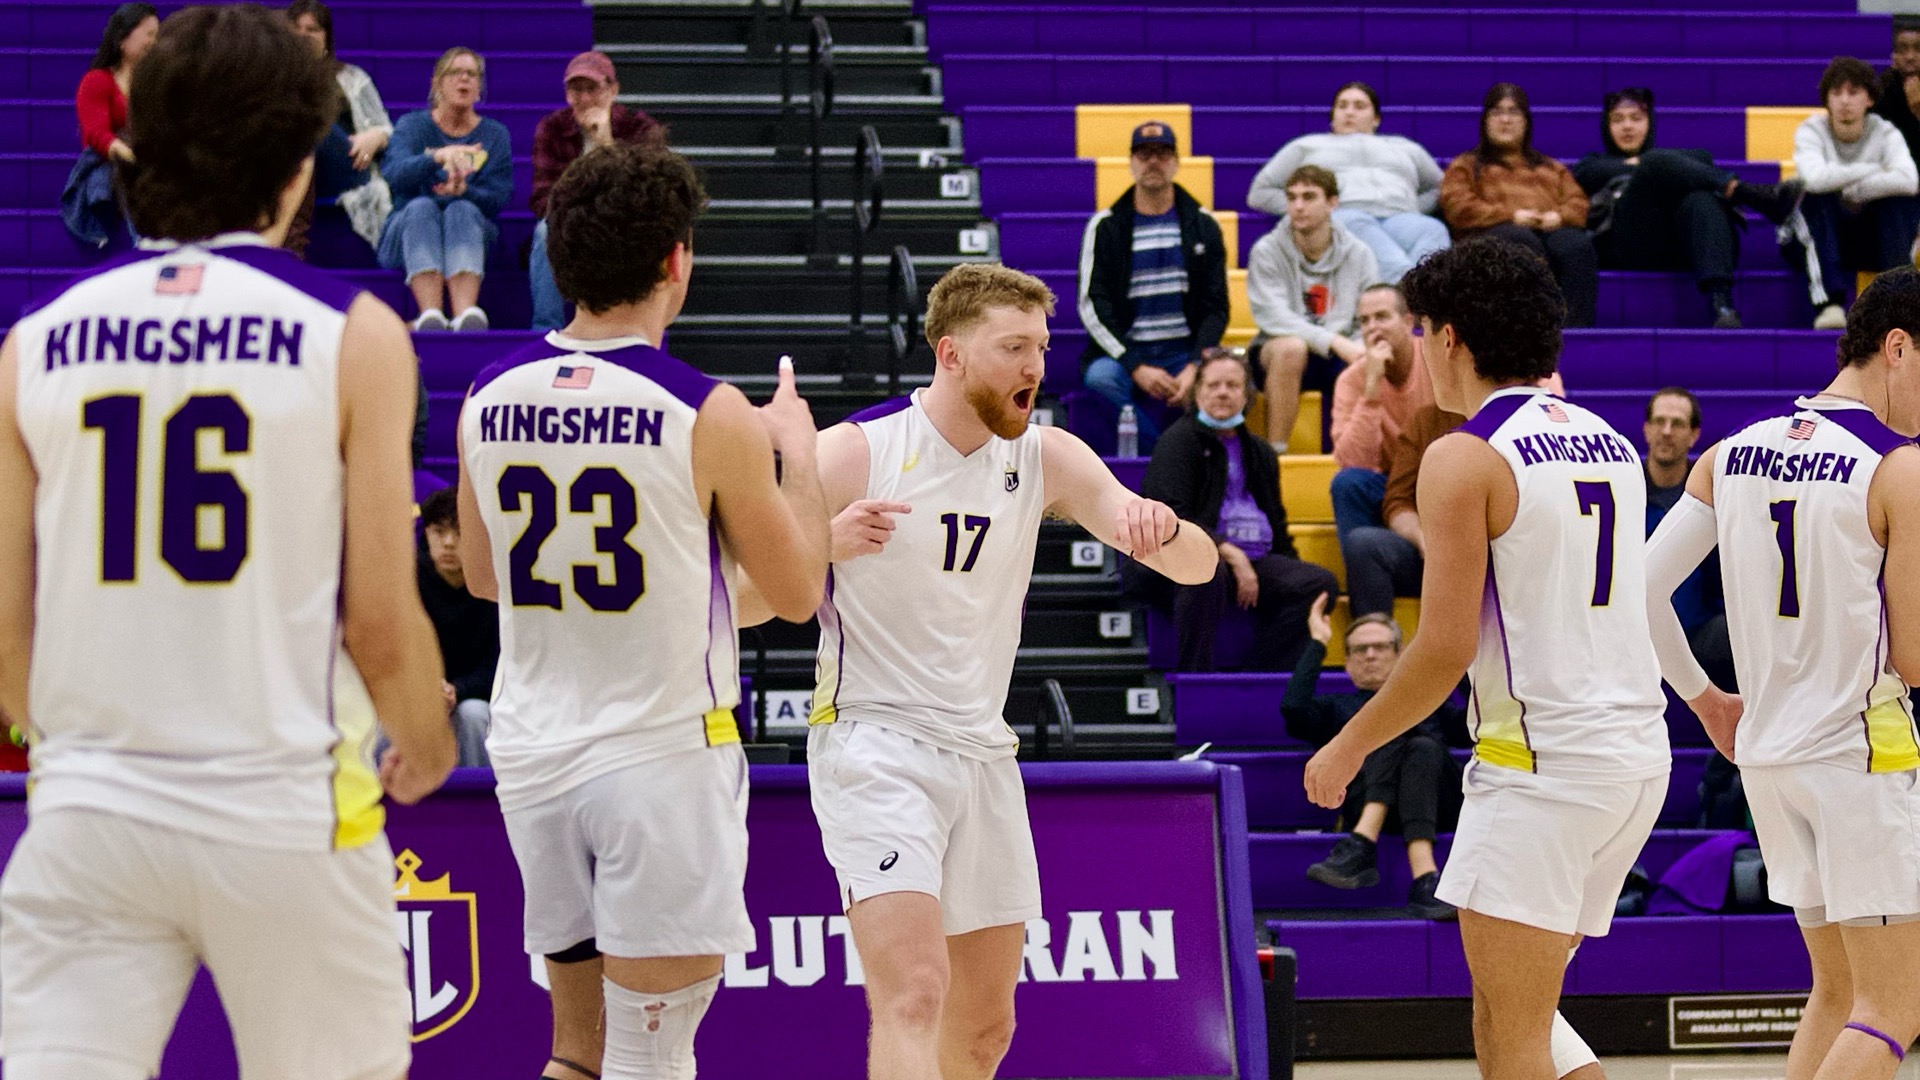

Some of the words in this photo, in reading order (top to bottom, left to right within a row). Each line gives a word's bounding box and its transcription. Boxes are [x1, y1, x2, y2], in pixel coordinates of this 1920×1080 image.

[947, 179, 965, 192] M
[45, 315, 304, 372] KINGSMEN
[480, 403, 665, 447] KINGSMEN
[1512, 432, 1636, 467] KINGSMEN
[1724, 445, 1859, 485] KINGSMEN
[80, 391, 253, 587] 16
[496, 463, 647, 614] 23
[939, 511, 993, 574] 17
[1079, 546, 1096, 562] G
[1572, 479, 1617, 608] 7
[1768, 498, 1802, 620] 1
[1109, 616, 1122, 633] F
[1137, 693, 1150, 709] E
